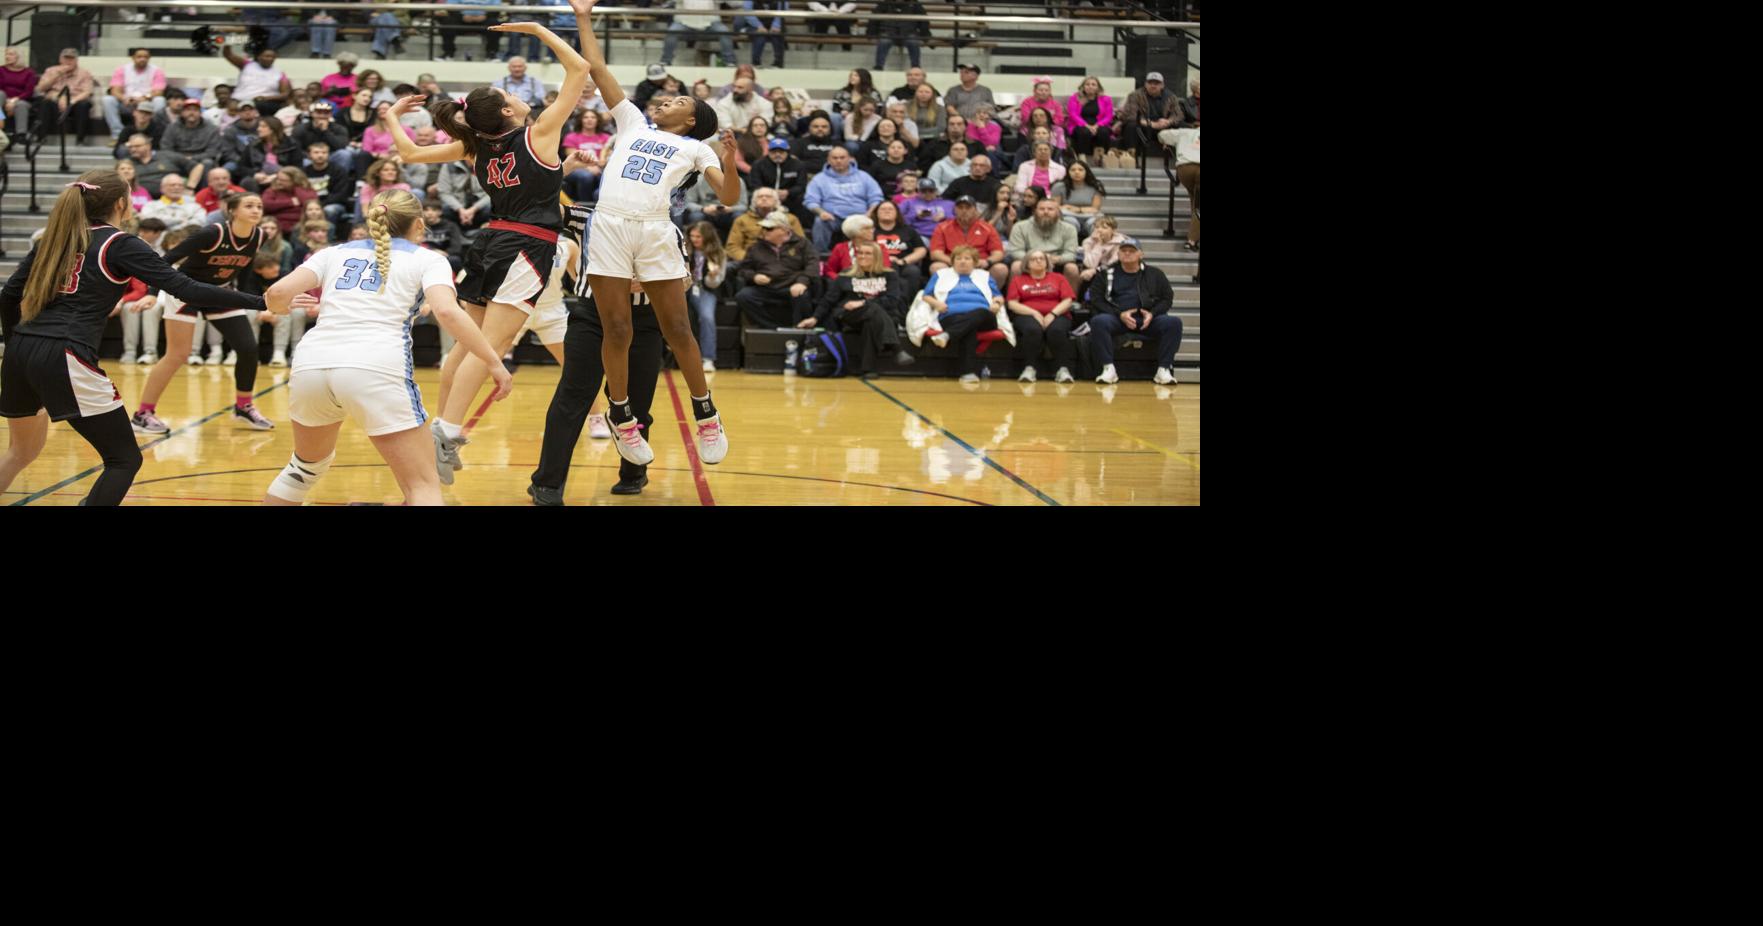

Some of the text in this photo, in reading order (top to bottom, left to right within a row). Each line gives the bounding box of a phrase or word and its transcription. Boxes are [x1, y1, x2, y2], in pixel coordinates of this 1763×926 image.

[629, 138, 679, 160] EAST
[486, 151, 520, 189] 42
[620, 155, 667, 185] 25
[334, 257, 383, 292] 33
